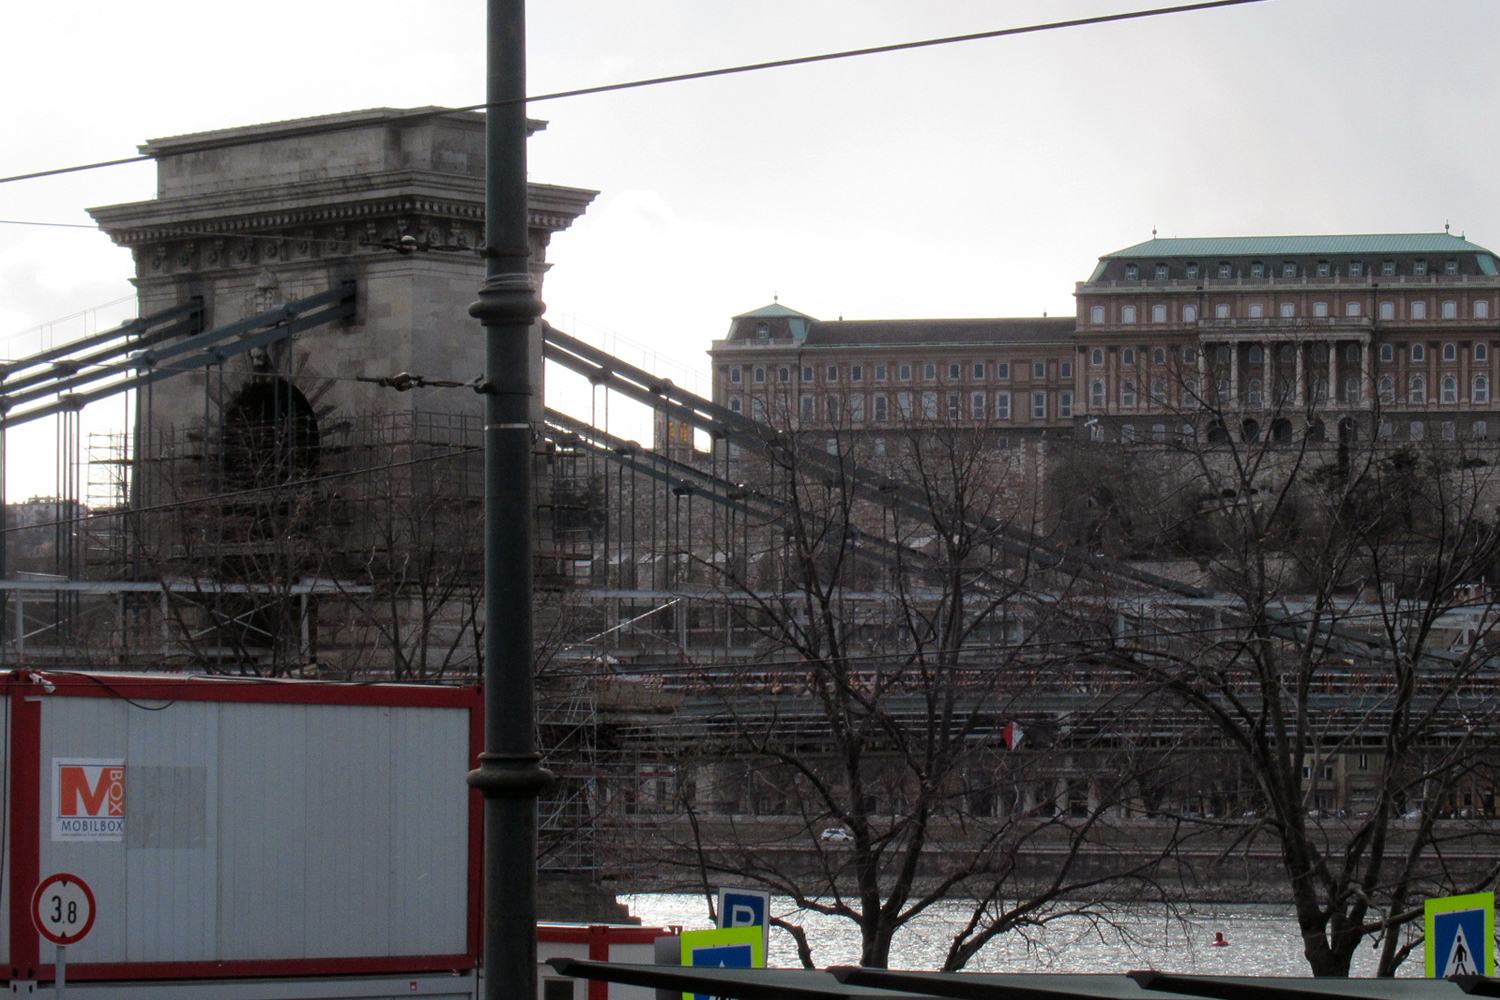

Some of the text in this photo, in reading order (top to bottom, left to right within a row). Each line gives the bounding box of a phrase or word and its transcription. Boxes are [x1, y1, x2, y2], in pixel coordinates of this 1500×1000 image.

[110, 770, 123, 814] BOX
[61, 820, 123, 832] MOBILBOX
[731, 904, 755, 928] P
